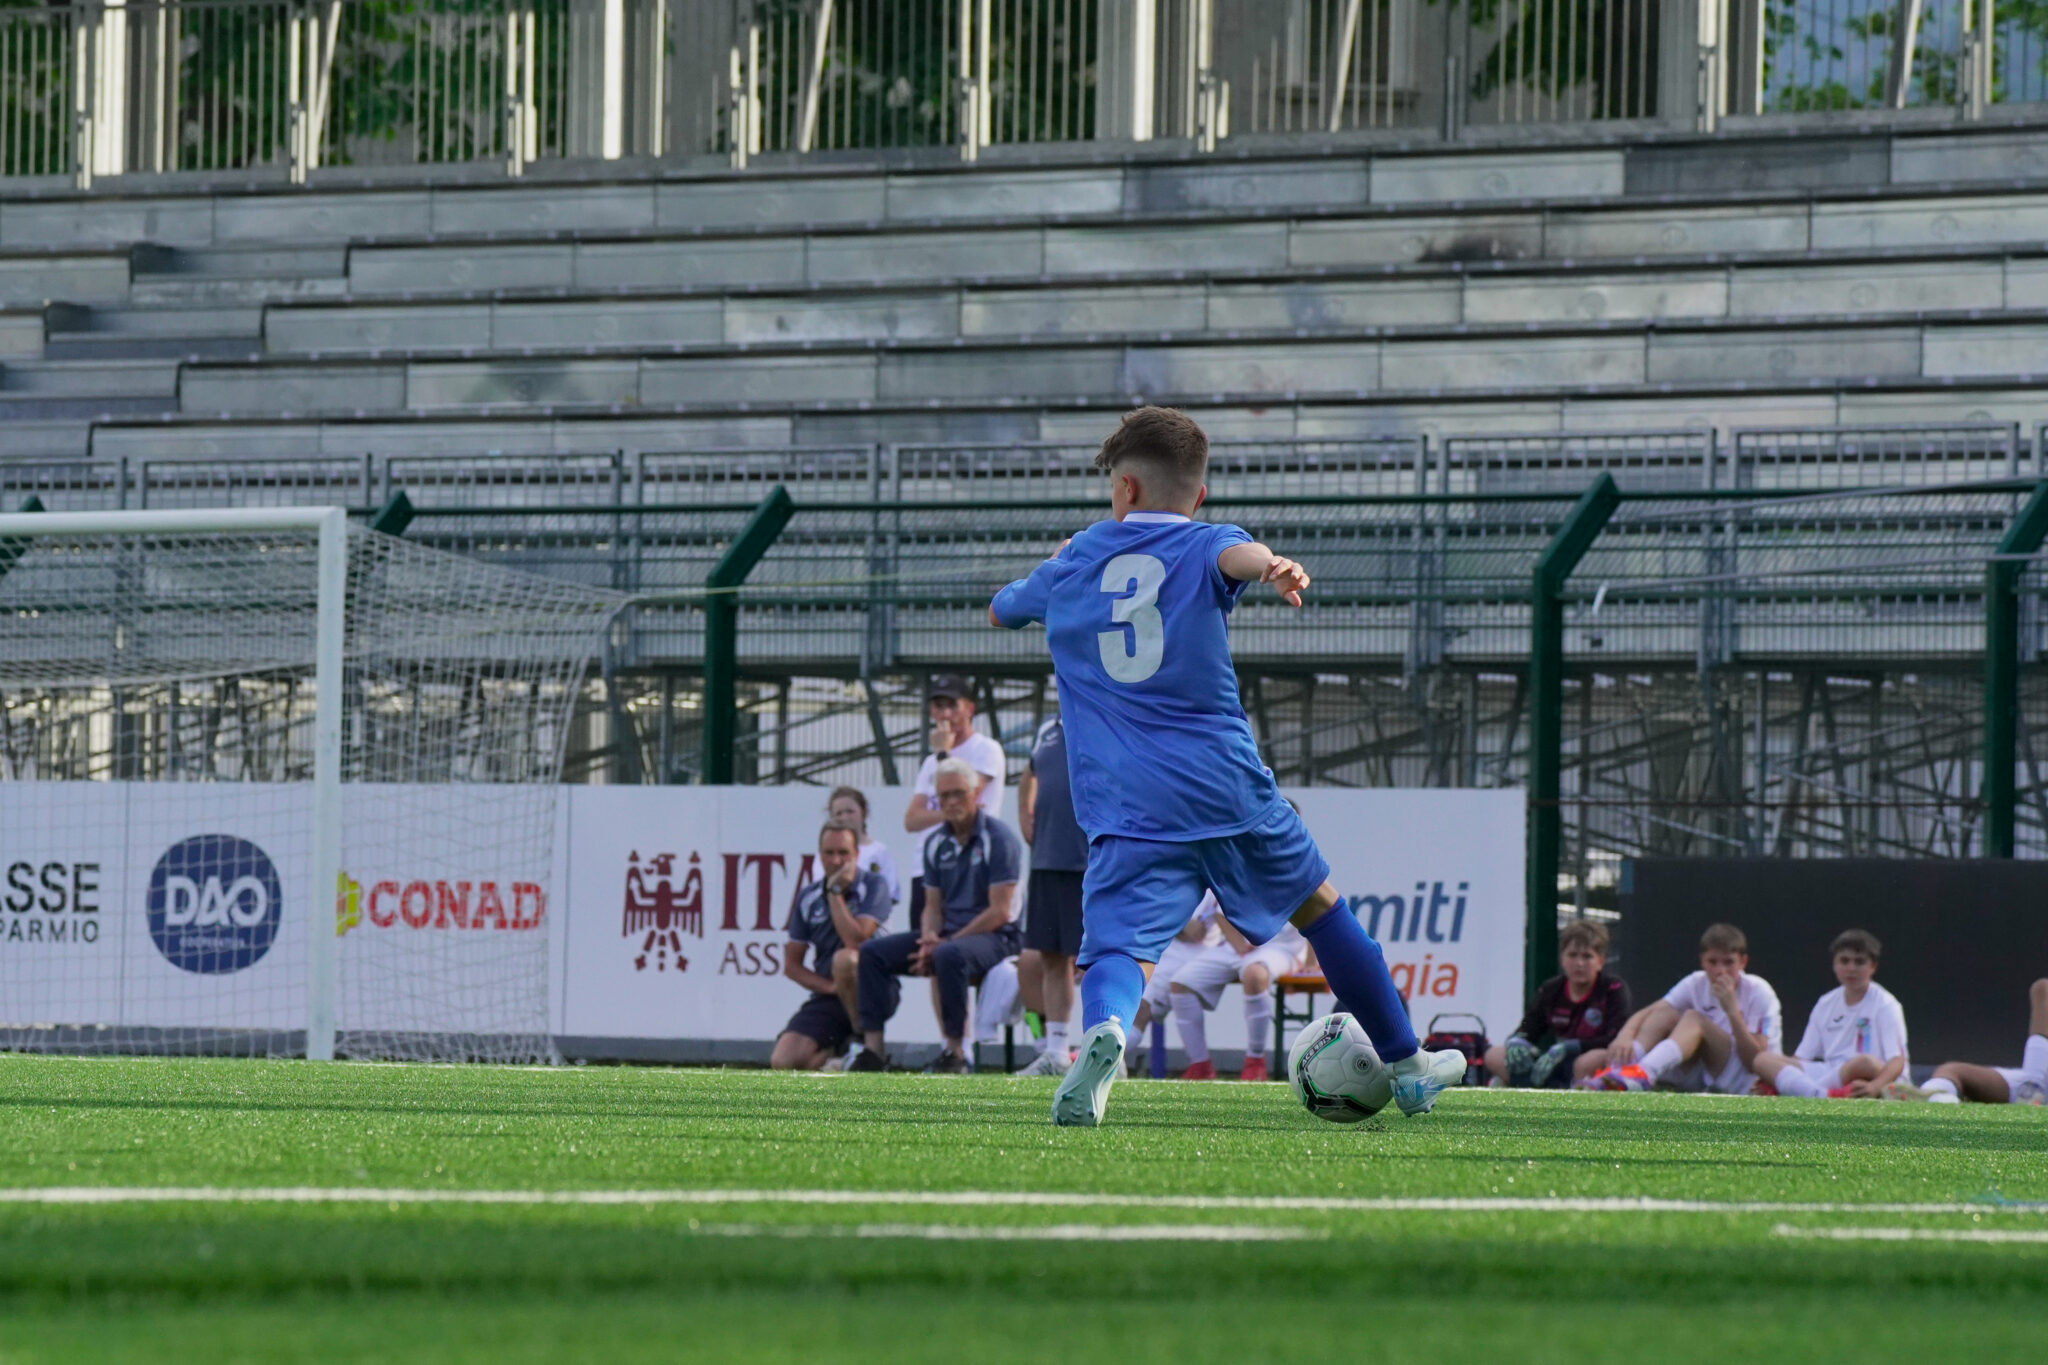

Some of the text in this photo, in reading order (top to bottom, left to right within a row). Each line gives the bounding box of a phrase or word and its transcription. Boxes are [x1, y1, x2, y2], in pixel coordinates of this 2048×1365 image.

[1097, 553, 1167, 683] 3
[0, 862, 101, 914] SSE
[166, 875, 268, 928] DAO
[368, 879, 546, 931] CONAD
[719, 853, 815, 932] ITA
[1347, 881, 1470, 944] miti
[718, 941, 786, 976] ASS
[1389, 953, 1459, 1004] gia
